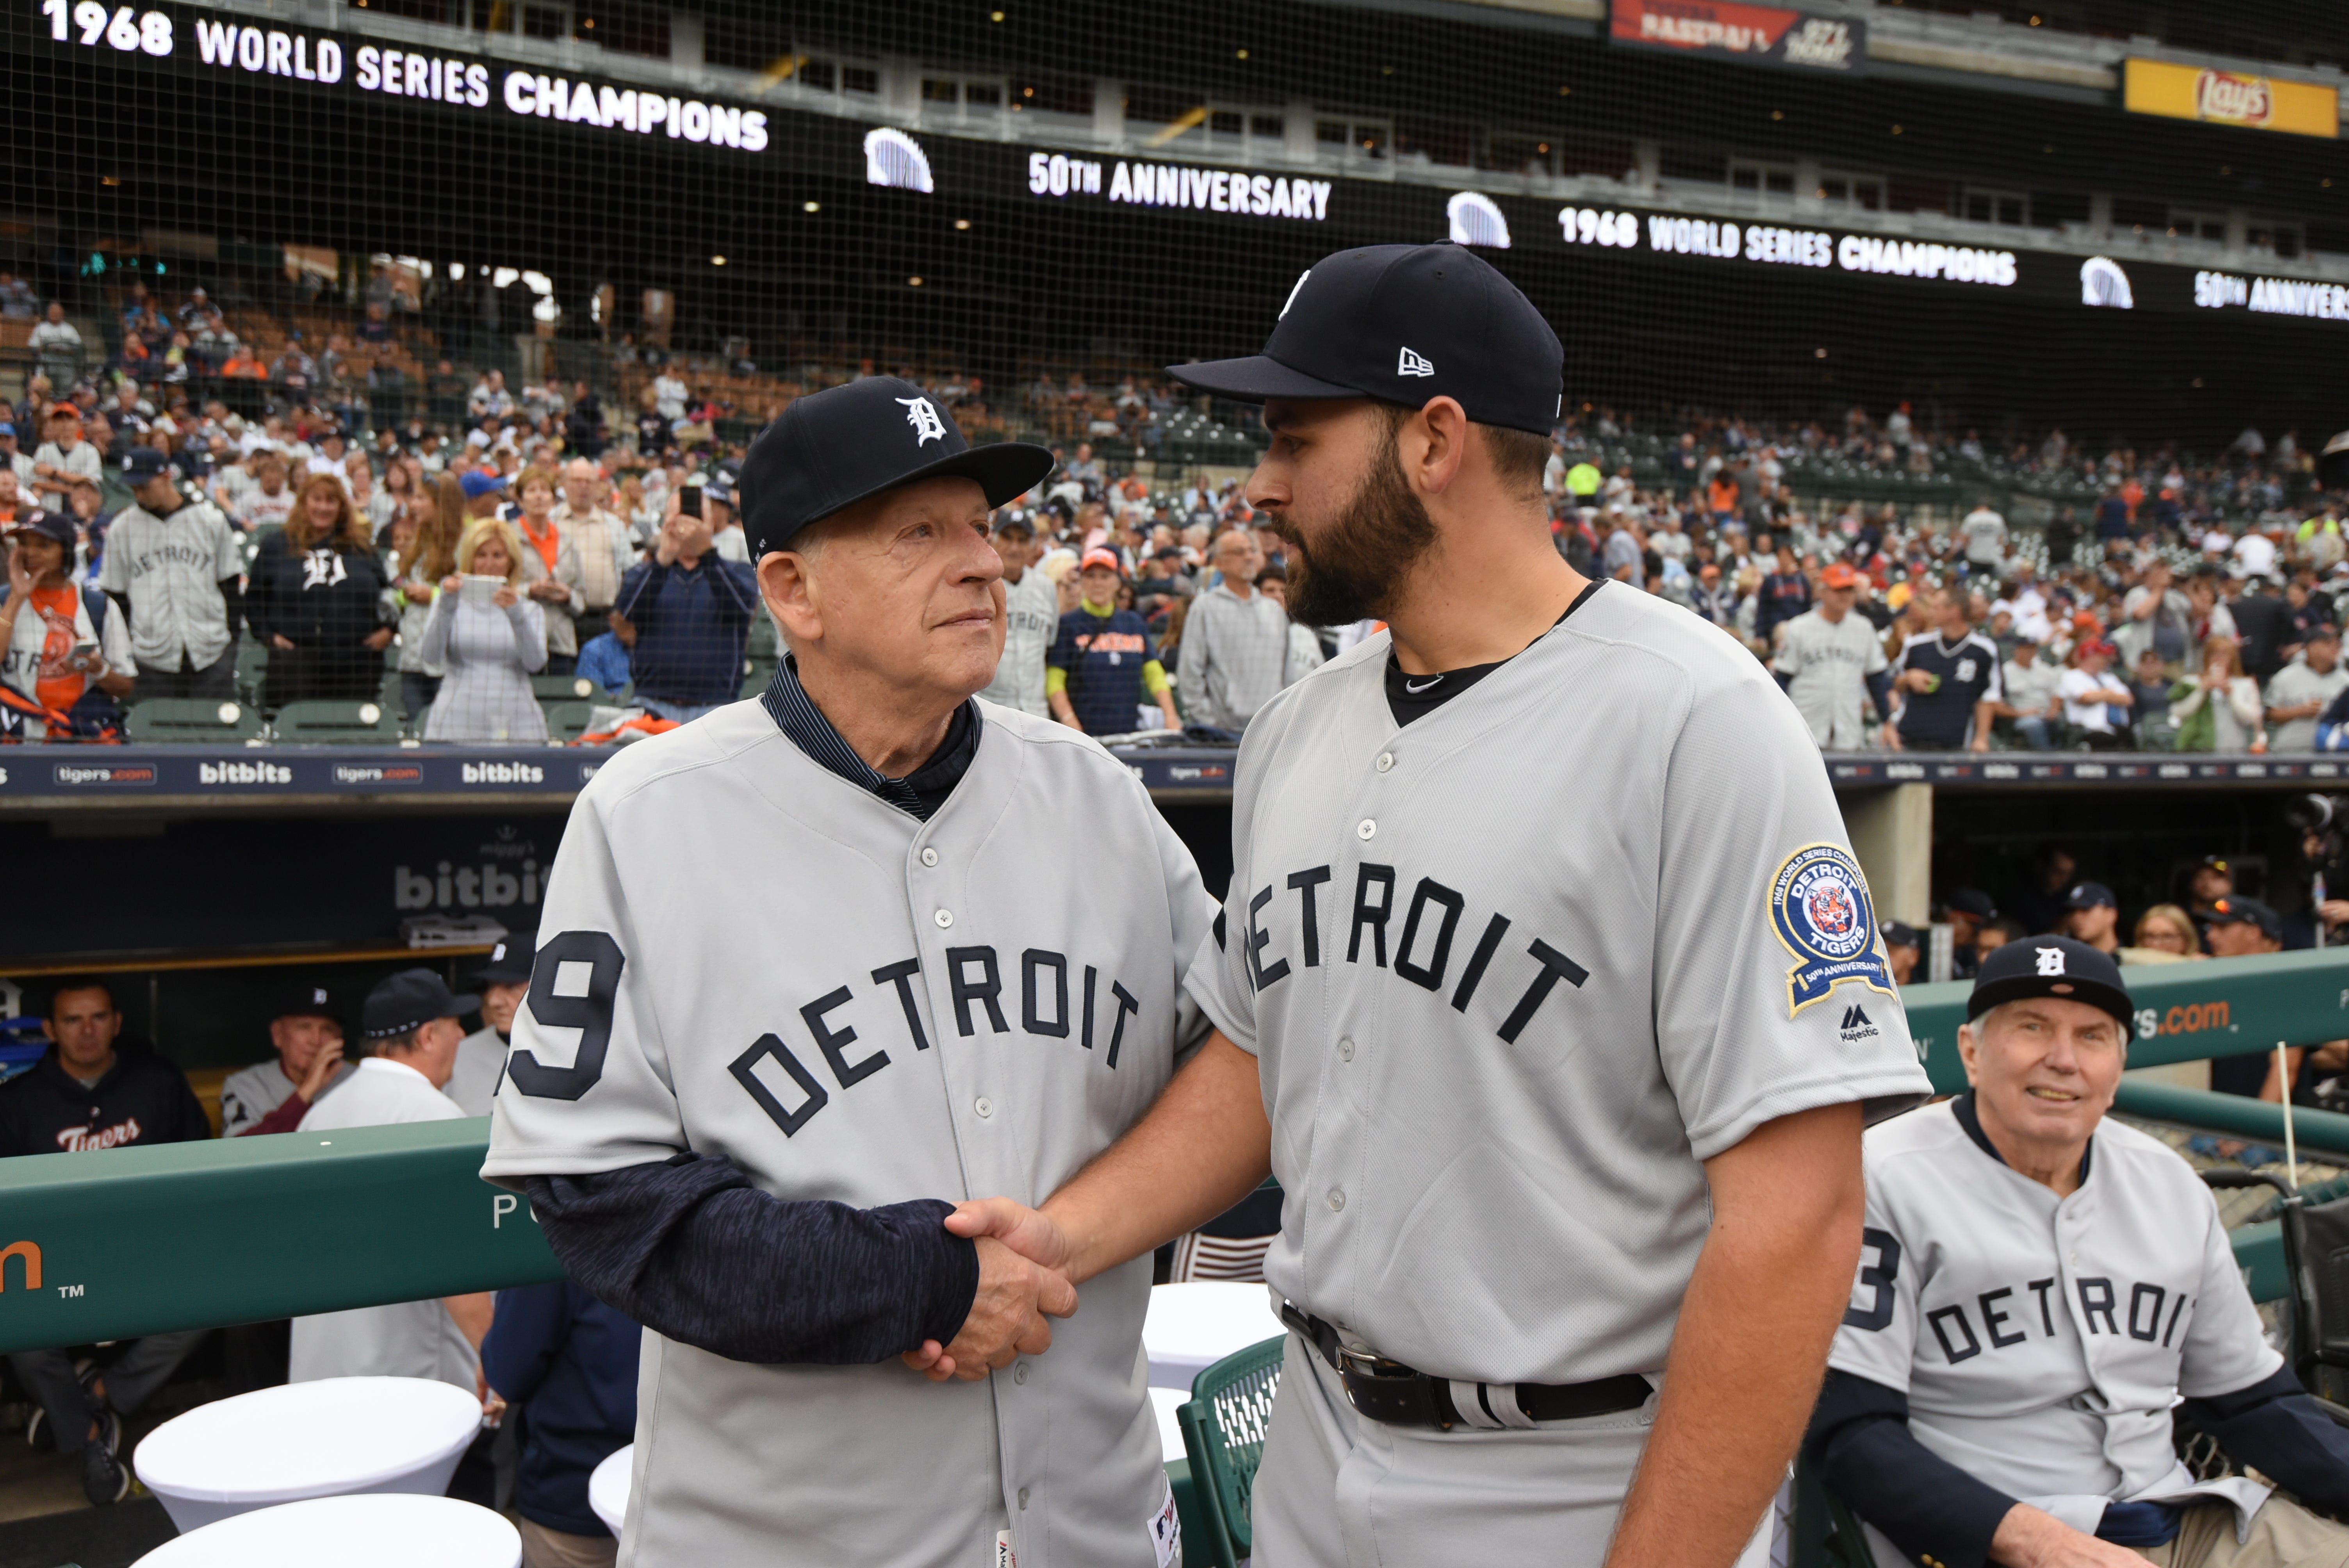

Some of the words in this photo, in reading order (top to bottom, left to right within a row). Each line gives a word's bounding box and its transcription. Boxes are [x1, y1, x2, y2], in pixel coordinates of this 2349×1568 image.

[43, 0, 173, 56] 1968
[196, 18, 342, 83] WORLD
[356, 45, 489, 107] SERIES
[503, 71, 768, 151] CHAMPIONS
[1029, 153, 1101, 196] 50TH
[1109, 161, 1331, 220] ANNIVERSARY
[1558, 207, 1639, 249] 1968
[1648, 216, 1740, 258] WORLD
[1745, 225, 1832, 267] SERIES
[1838, 235, 2017, 287] CHAMPIONS
[895, 396, 947, 447] D
[59, 766, 153, 784] tigers.com
[199, 760, 292, 784] bitbits
[336, 766, 419, 783] tigers.com
[462, 761, 544, 784] bitbits
[1802, 848, 1833, 861] SERIES
[1777, 855, 1804, 886] WORLD
[1790, 864, 1858, 899] DETROIT
[1833, 850, 1867, 894] CHAMPIONS
[1773, 886, 1784, 905] 1968
[1810, 926, 1865, 955] TIGERS
[1824, 962, 1880, 976] ANNIVERSARY
[2035, 947, 2065, 976] D
[727, 945, 1139, 1138] DETROIT
[1840, 1027, 1878, 1042] Majestic
[1926, 1277, 2197, 1365] DETROI
